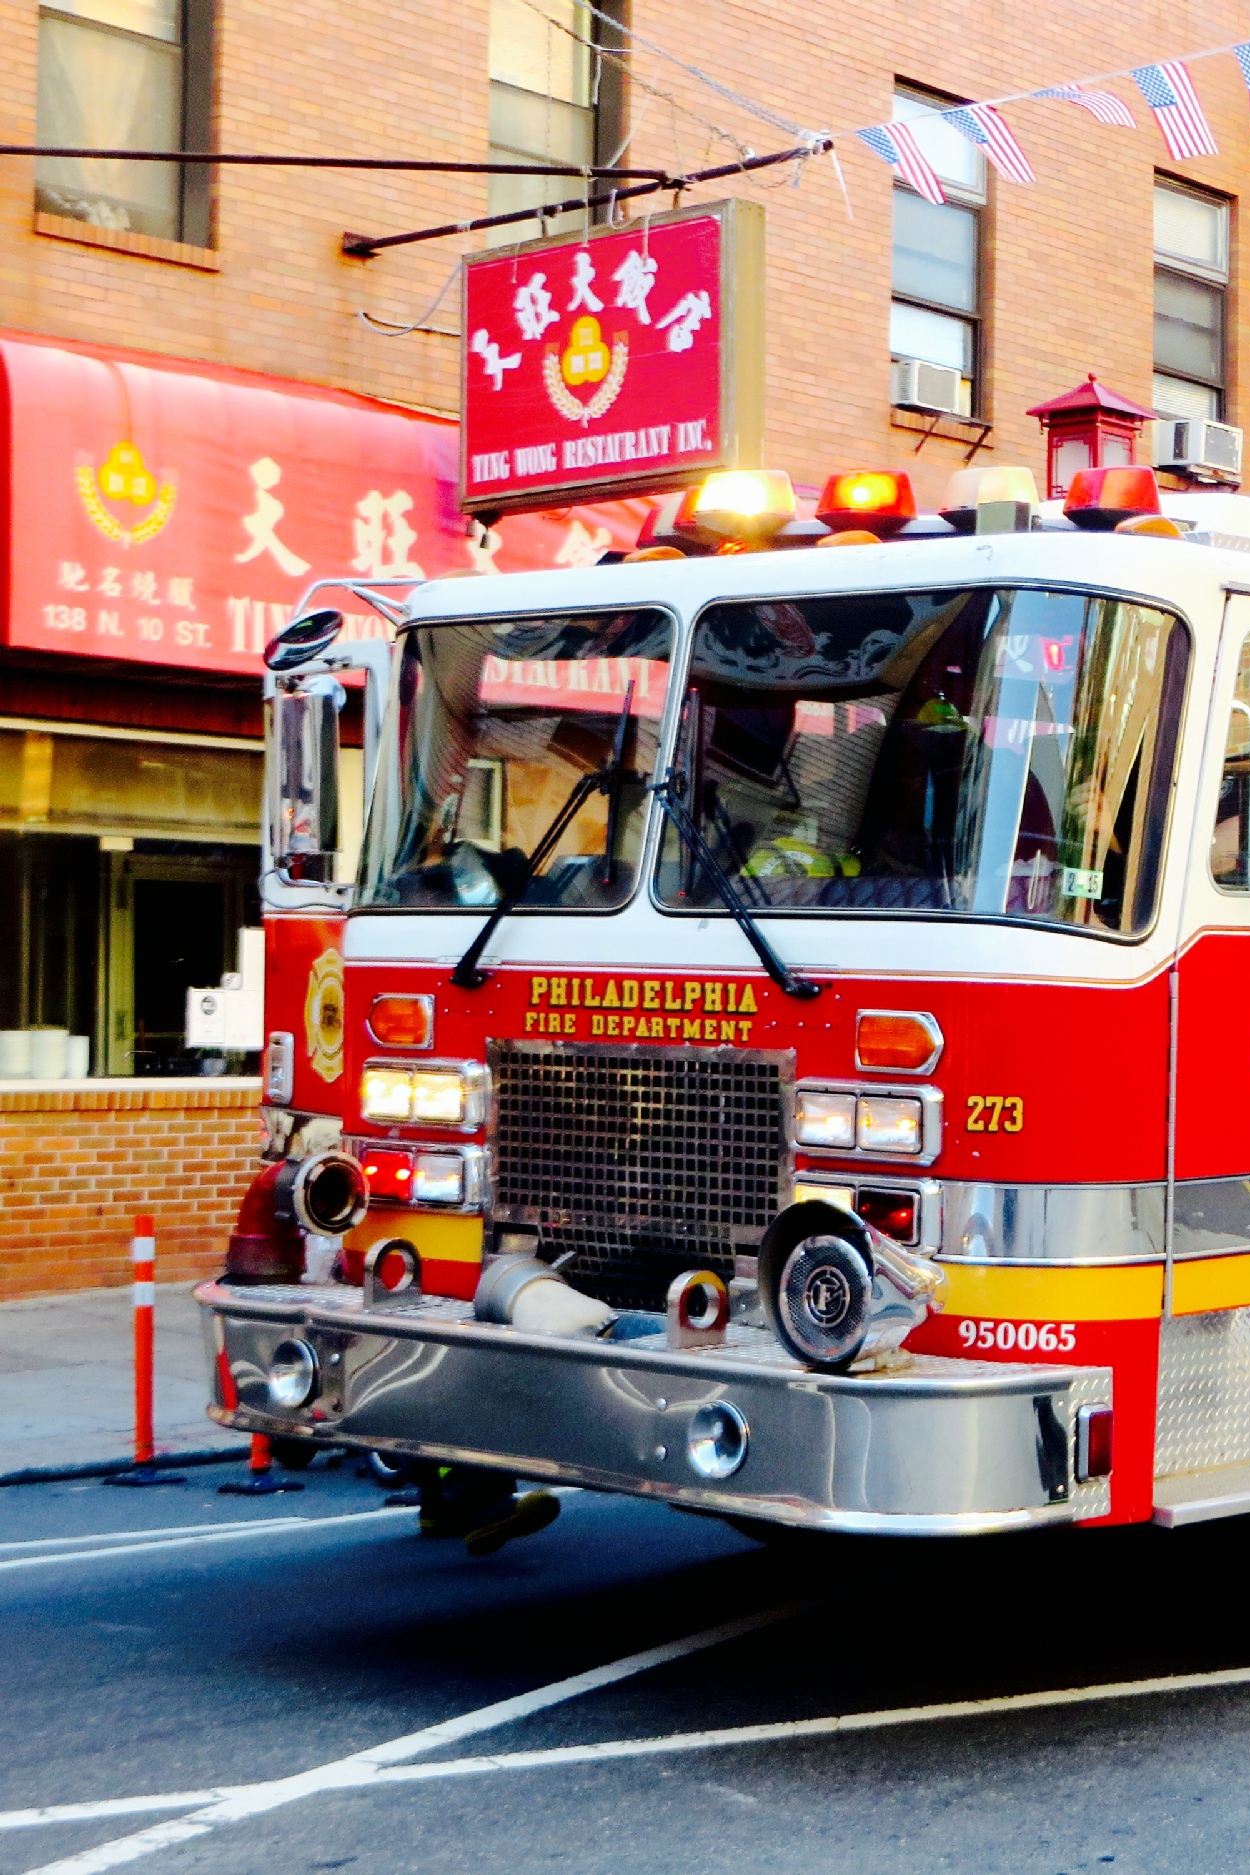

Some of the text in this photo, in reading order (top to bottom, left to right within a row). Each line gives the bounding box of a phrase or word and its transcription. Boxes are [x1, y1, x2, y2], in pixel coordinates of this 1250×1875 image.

[472, 450, 510, 483] TING
[515, 442, 556, 475] WONG
[562, 424, 670, 469] RESTAURANT
[43, 604, 212, 647] 138 N. 10 ST.
[531, 976, 758, 1013] PHILADELPHIA
[525, 1012, 752, 1042] FIRE DEPARTMENT
[966, 1095, 1024, 1132] 273
[958, 1319, 1077, 1351] 950065
